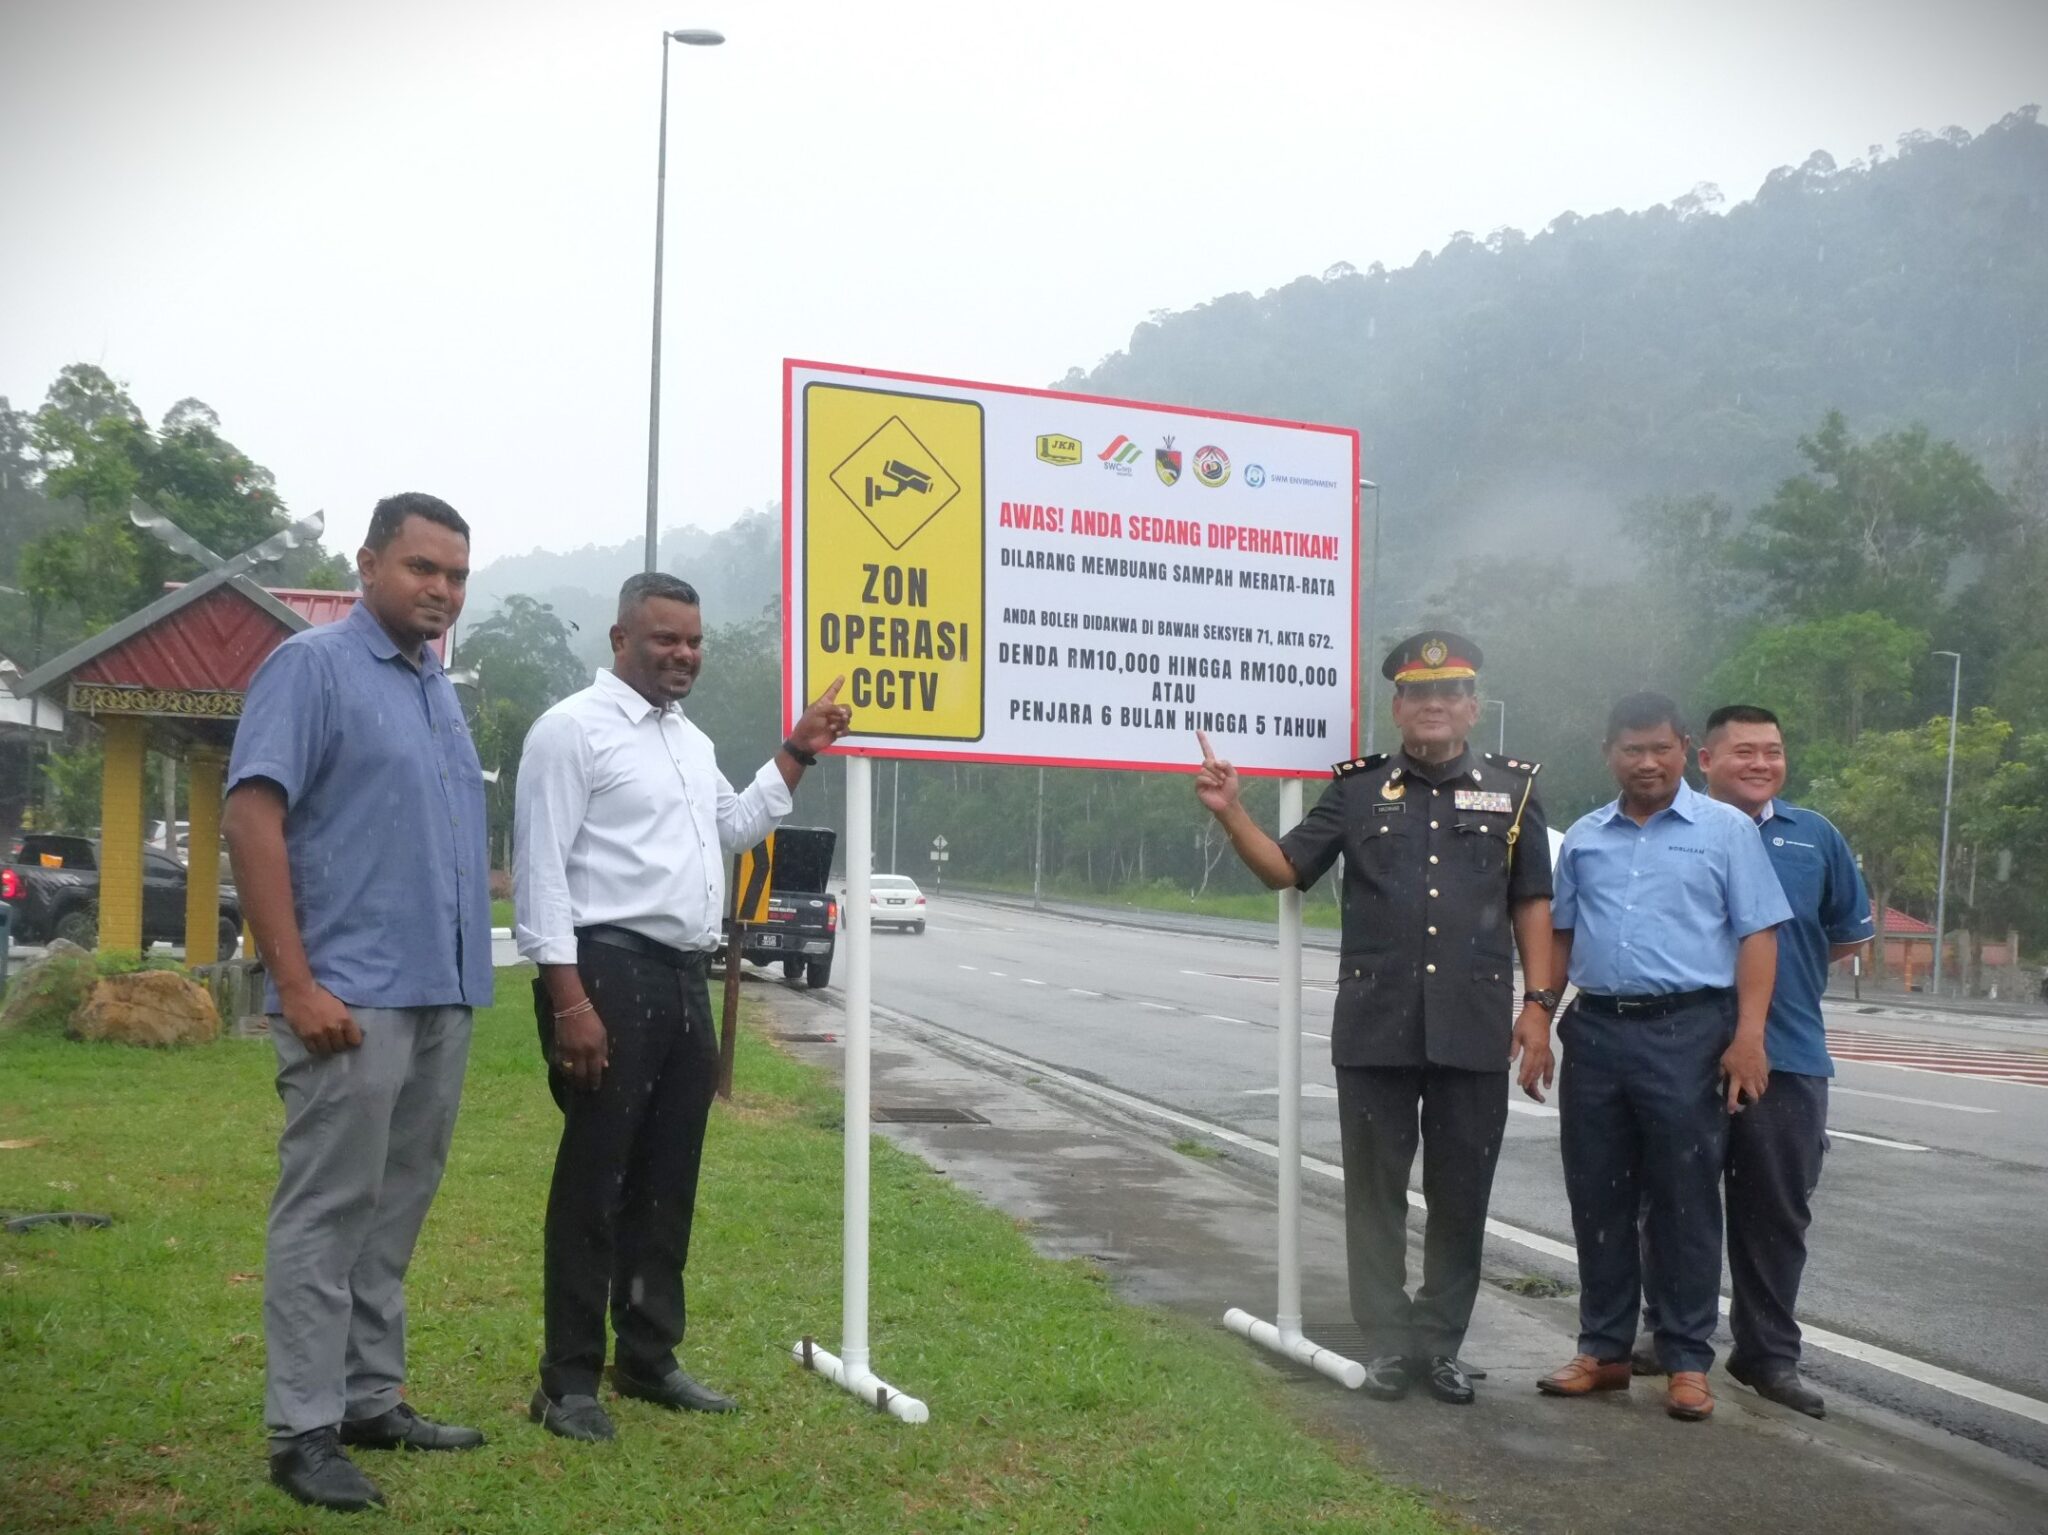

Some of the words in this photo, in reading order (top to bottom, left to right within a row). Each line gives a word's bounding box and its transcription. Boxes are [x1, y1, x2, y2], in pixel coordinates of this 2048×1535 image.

[1052, 440, 1075, 450] JKR
[1271, 474, 1288, 483] SWM
[1290, 476, 1337, 489] ENVIRONMENT
[1000, 502, 1064, 533] AWAS!
[1071, 509, 1122, 538] ANDA
[1129, 515, 1200, 547] SEDANG
[1208, 523, 1338, 561] DIPERHATIKAN!
[862, 563, 927, 607] ZON
[1001, 548, 1075, 572] DILARANG
[1082, 555, 1167, 581] MEMBUANG
[1173, 564, 1233, 587] SAMPAH
[1239, 571, 1335, 597] MERATA-RATA
[820, 612, 968, 662] OPERASI
[1003, 608, 1036, 625] ANDA
[1041, 611, 1078, 629] BOLEH
[1083, 614, 1138, 634] DIDAKWA
[1142, 619, 1154, 635] DI
[1158, 621, 1199, 639] BAWAH
[1203, 624, 1253, 643] SEKSYEN
[1257, 629, 1273, 646] 71,
[1277, 630, 1305, 647] AKTA
[1308, 633, 1334, 650] 672.
[999, 642, 1059, 667] DENDA
[1068, 648, 1160, 674] RM10,000
[1168, 655, 1232, 680] HINGGA
[1240, 661, 1337, 687] RM100,000
[852, 667, 938, 712] CCTV
[1152, 681, 1195, 704] ATAU
[1010, 699, 1092, 725] PENJARA
[1101, 705, 1112, 726] 6
[1120, 707, 1176, 730] BULAN
[1185, 711, 1248, 734] HINGGA
[1256, 715, 1266, 735] 5
[1274, 716, 1326, 739] TAHUN
